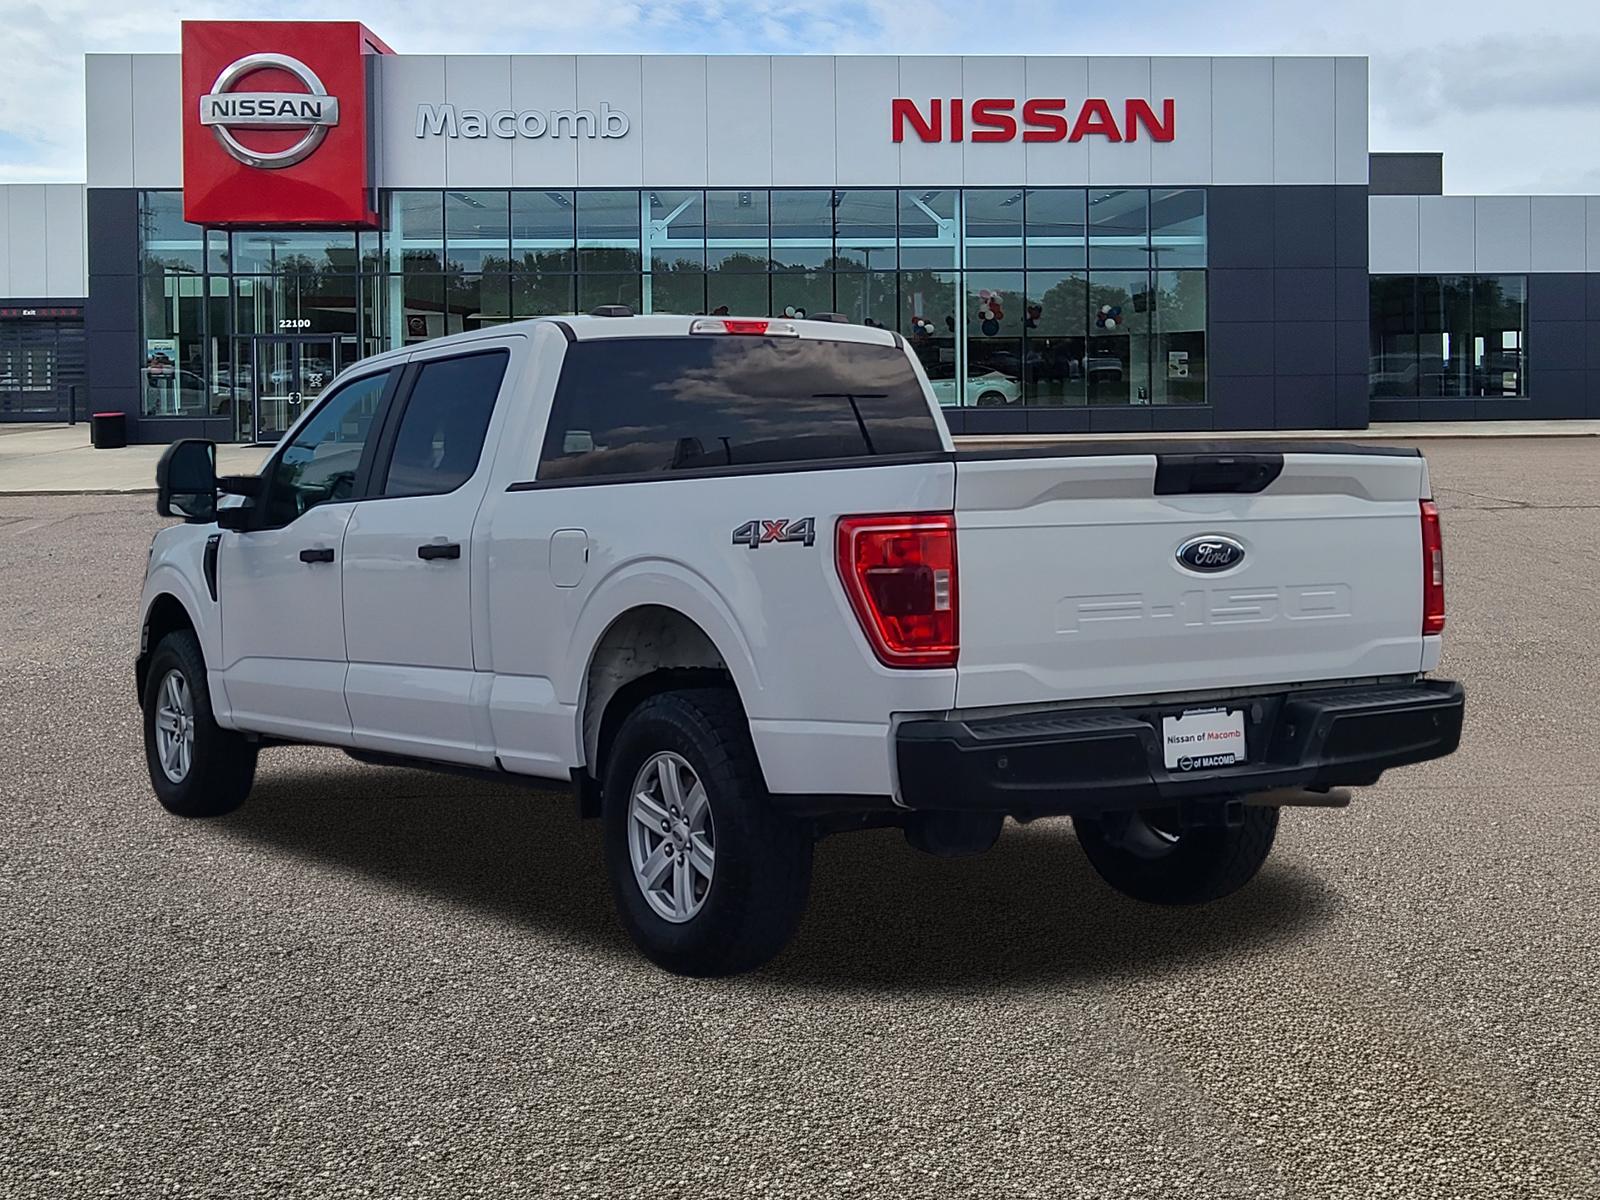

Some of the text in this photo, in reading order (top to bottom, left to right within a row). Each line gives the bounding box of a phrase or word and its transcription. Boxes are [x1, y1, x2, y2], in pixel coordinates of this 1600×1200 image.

[211, 100, 322, 118] NISSAN
[415, 102, 630, 139] Macomb
[892, 98, 1176, 143] NISSAN
[279, 319, 311, 328] 22100
[1195, 543, 1232, 564] Ford
[1056, 583, 1352, 634] F-150
[1167, 729, 1241, 745] Nissan of Macomb
[1193, 755, 1235, 768] of MACOMB
